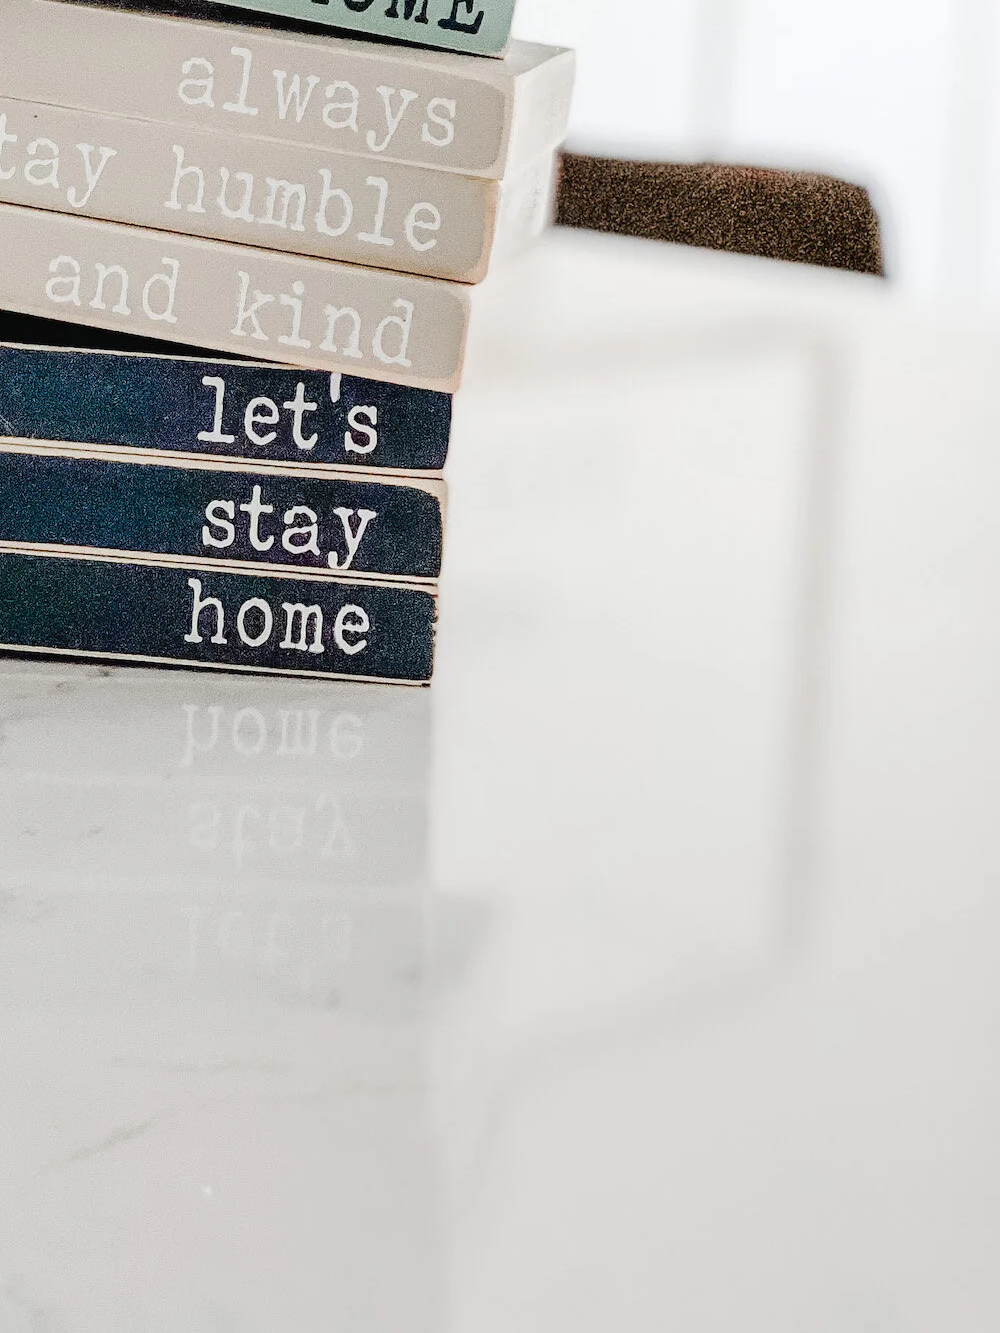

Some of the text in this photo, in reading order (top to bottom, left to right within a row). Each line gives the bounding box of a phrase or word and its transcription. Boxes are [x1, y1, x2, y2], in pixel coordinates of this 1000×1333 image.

[178, 46, 458, 153] always
[164, 145, 442, 252] humble
[45, 254, 413, 368] and kind
[197, 372, 379, 455] let's
[202, 484, 378, 570] stay
[184, 577, 370, 656] home
